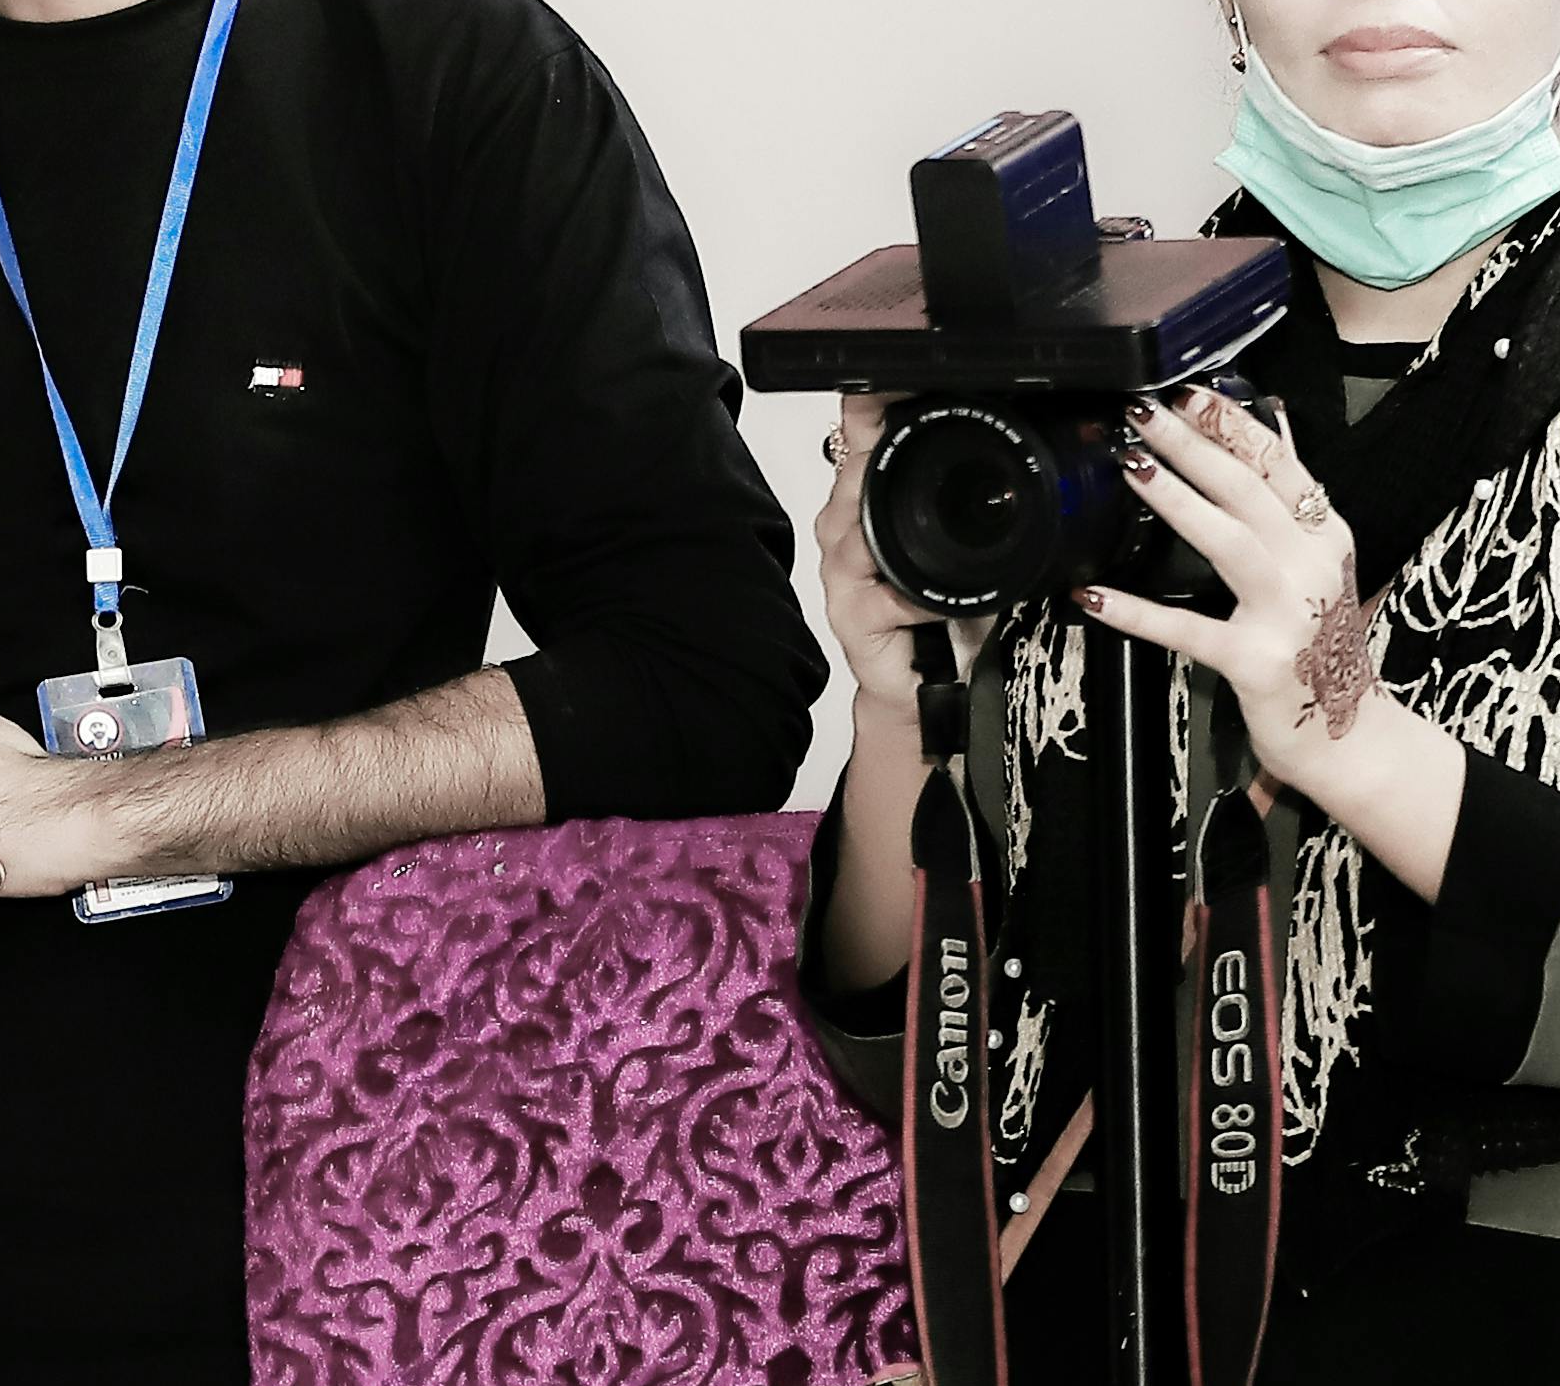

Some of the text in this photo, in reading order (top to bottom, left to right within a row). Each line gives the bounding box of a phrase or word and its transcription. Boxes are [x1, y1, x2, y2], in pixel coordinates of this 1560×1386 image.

[931, 938, 970, 1128] Canon
[1211, 950, 1256, 1194] EOS 80D
